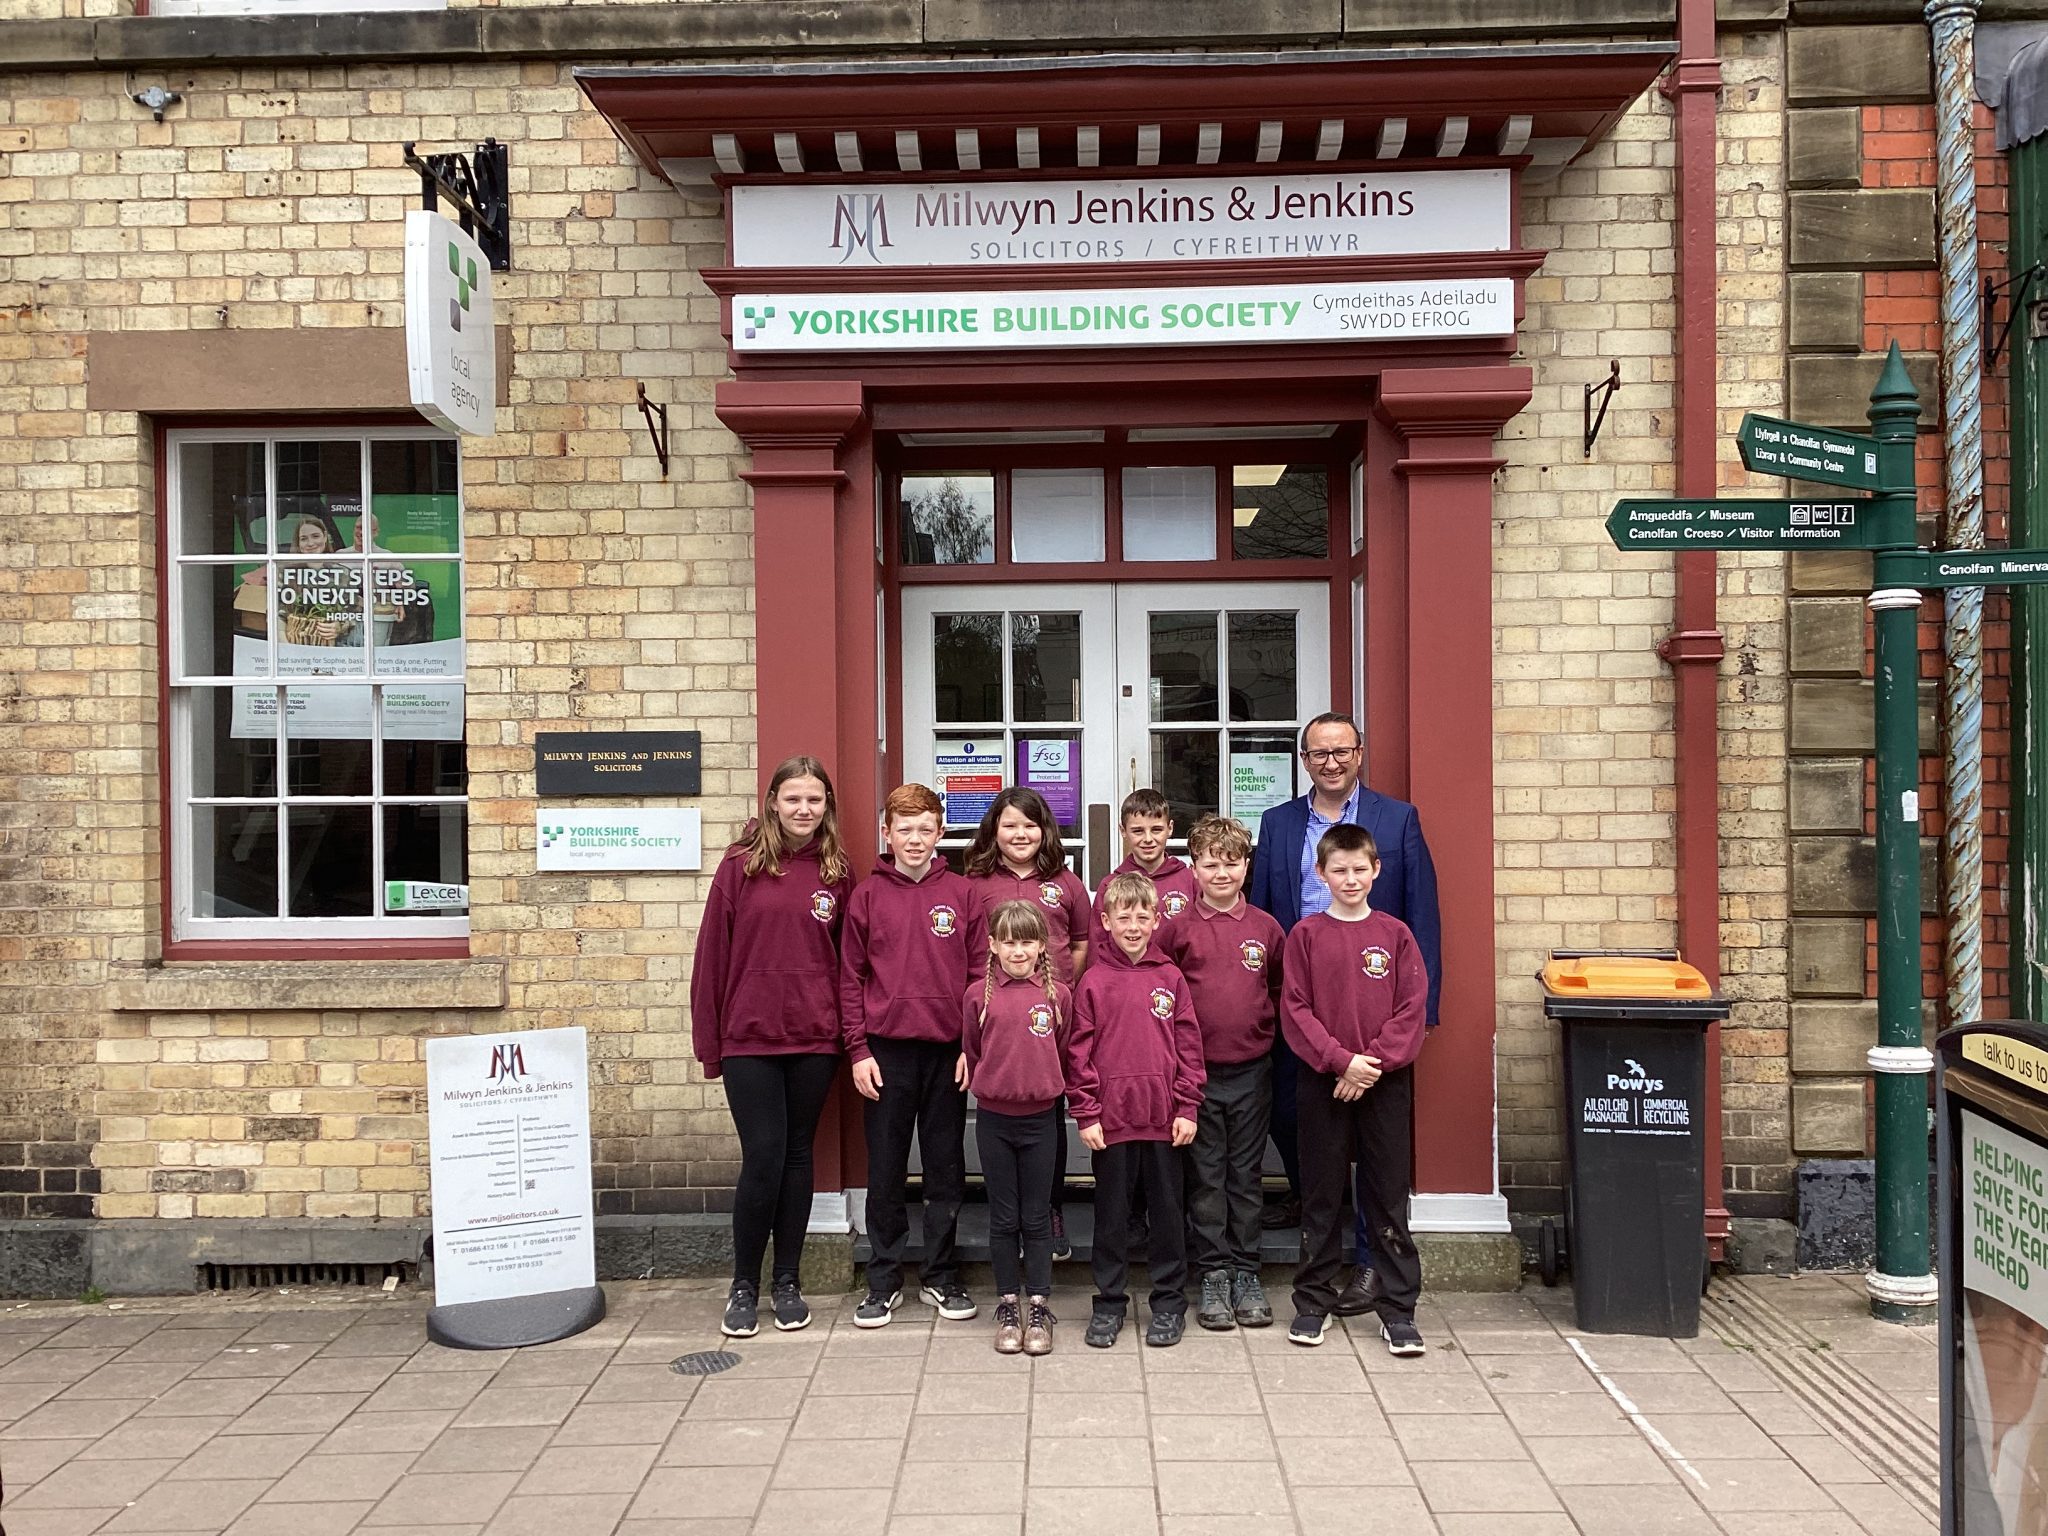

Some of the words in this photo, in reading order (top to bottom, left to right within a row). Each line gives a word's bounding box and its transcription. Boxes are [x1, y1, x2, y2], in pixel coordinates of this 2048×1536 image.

[915, 190, 1056, 236] Milwyn
[1068, 187, 1215, 225] Jenkins
[1228, 186, 1255, 221] &
[1265, 181, 1414, 220] Jenkins
[970, 239, 1125, 260] SOLICITORS
[1145, 239, 1154, 257] /
[1173, 233, 1360, 257] CYFREITHWYR
[1313, 292, 1415, 314] Cymdeithas
[1420, 289, 1497, 307] Adeiladu
[788, 308, 978, 335] YORKSHIRE
[993, 304, 1150, 332] BUILDING
[1161, 301, 1301, 329] SOCIETY
[1340, 313, 1406, 330] SWYDD
[1412, 311, 1471, 328] EFROG
[450, 347, 471, 380] local
[451, 381, 481, 418] agency
[1755, 427, 1780, 443] Llyfrgell
[1782, 435, 1788, 444] a
[1789, 433, 1820, 450] Chanolfan
[1822, 440, 1855, 456] Gymunedol
[1755, 447, 1777, 463] Library
[1780, 452, 1786, 463] &
[1788, 454, 1822, 471] Community
[1824, 459, 1845, 473] Centre
[331, 504, 363, 512] SAVING
[1815, 511, 1830, 519] WC
[1629, 510, 1693, 523] Amgueddfa
[1697, 510, 1706, 520] /
[1709, 510, 1755, 521] Museum
[1629, 527, 1678, 539] Canolfan
[1683, 527, 1724, 539] Croeso
[1727, 528, 1737, 538] /
[1739, 527, 1775, 538] Visitor
[1780, 527, 1841, 538] Information
[1940, 563, 1995, 576] Canolfan
[2001, 561, 2048, 573] Minerva
[284, 568, 344, 587] FIRST
[349, 569, 414, 587] SEPS
[278, 587, 297, 605] O
[302, 588, 360, 605] NEXT
[326, 612, 364, 622] HAPPE
[290, 658, 311, 666] saving
[312, 656, 321, 664] for
[394, 657, 406, 668] day
[423, 657, 447, 667] Putting
[543, 751, 583, 761] MILWYN
[587, 751, 627, 762] JENKINS
[631, 752, 649, 760] AND
[653, 751, 692, 761] JENKINS
[593, 764, 642, 772] SOLICITORS
[1234, 767, 1254, 775] OUR
[1234, 775, 1276, 784] OPENING
[1234, 783, 1267, 792] HOURS
[569, 826, 640, 837] YORKSHIRE
[569, 837, 628, 848] BUILDING
[630, 837, 682, 848] SOCIETY
[584, 851, 605, 859] agency
[412, 884, 462, 899] Lexcel
[1983, 1039, 2002, 1064] talk
[2004, 1047, 2015, 1071] to
[2018, 1059, 2032, 1079] us
[443, 1089, 482, 1101] Milwyn
[484, 1085, 523, 1098] Jenkins
[525, 1083, 533, 1093] &
[535, 1080, 573, 1093] Jenkins
[1607, 1074, 1664, 1094] Powys
[460, 1099, 501, 1108] SOLICITORS
[509, 1093, 558, 1104] CYFREITHWYR
[1643, 1098, 1689, 1111] COMMERCIAL
[1583, 1110, 1630, 1123] MASNACHOL
[1643, 1111, 1690, 1125] RECYCLING
[1973, 1136, 2043, 1198] HELPING
[1973, 1171, 2014, 1216] SAVE
[467, 1207, 560, 1226] www.mjjsolicitors.co.uk
[1973, 1202, 2004, 1243] THE
[488, 1265, 493, 1273] T
[1973, 1235, 2030, 1292] AHEAD
